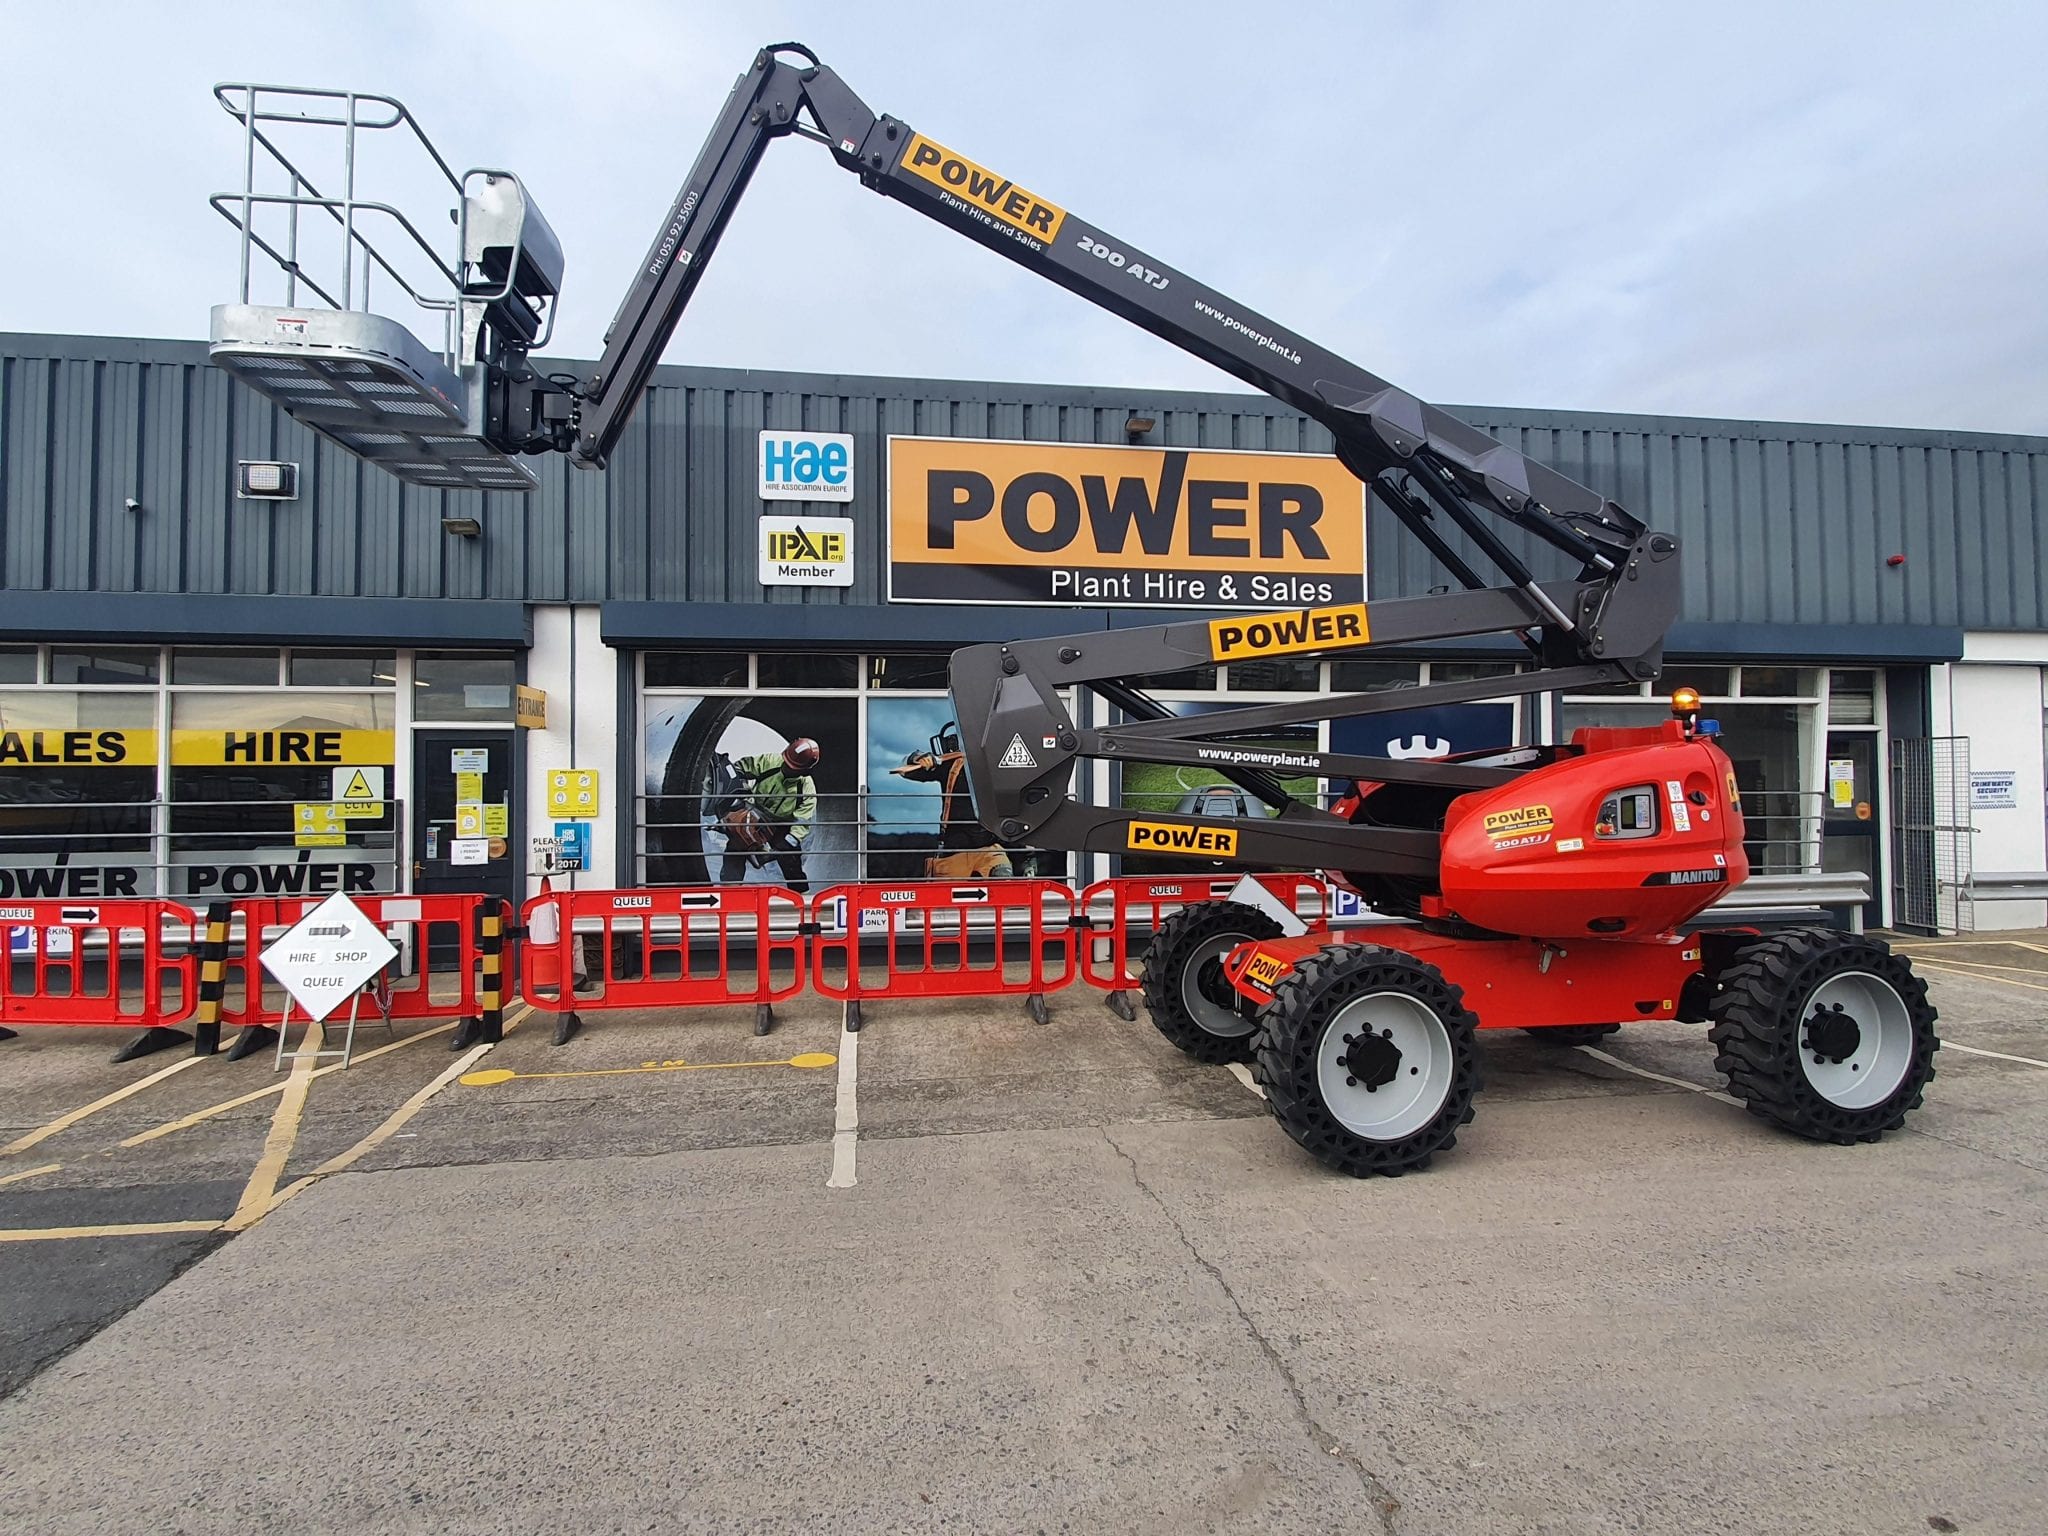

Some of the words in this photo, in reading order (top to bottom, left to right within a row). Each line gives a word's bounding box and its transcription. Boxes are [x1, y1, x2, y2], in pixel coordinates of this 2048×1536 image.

[911, 142, 1055, 234] POWER
[939, 191, 968, 212] Plant
[969, 207, 992, 226] Hire
[993, 220, 1016, 237] and
[1015, 231, 1043, 251] Sales
[649, 255, 665, 275] PH:
[659, 236, 675, 257] 053
[670, 222, 683, 237] 92
[677, 191, 699, 222] 35003
[1076, 235, 1126, 267] 200
[1127, 262, 1170, 290] ATJ
[1194, 300, 1302, 365] www.powerplant.ie
[927, 451, 1331, 560] POWER
[770, 525, 839, 560] IPAF
[778, 565, 835, 577] Member
[1050, 570, 1131, 599] Plant
[1144, 574, 1205, 600] Hire
[1219, 575, 1239, 601] &
[1250, 576, 1333, 602] Sales
[1218, 610, 1362, 652] POWER
[224, 731, 342, 762] HIRE
[1013, 746, 1023, 755] 13
[1198, 748, 1321, 768] www.powerplant.ie
[344, 802, 373, 810] CCTV
[1486, 807, 1548, 827] POWER
[533, 837, 564, 845] PLEASE
[1134, 826, 1232, 851] POWER
[557, 859, 579, 869] 2017
[1717, 855, 1723, 863] 4
[187, 849, 376, 898] POWER
[1670, 869, 1720, 884] MANITOU
[881, 891, 916, 901] QUEUE
[1150, 885, 1182, 895] QUEUE
[613, 896, 650, 907] QUEUE
[0, 909, 33, 919] QUEUE
[289, 952, 317, 962] HIRE
[335, 952, 368, 962] SHOP
[303, 977, 345, 988] QUEUE
